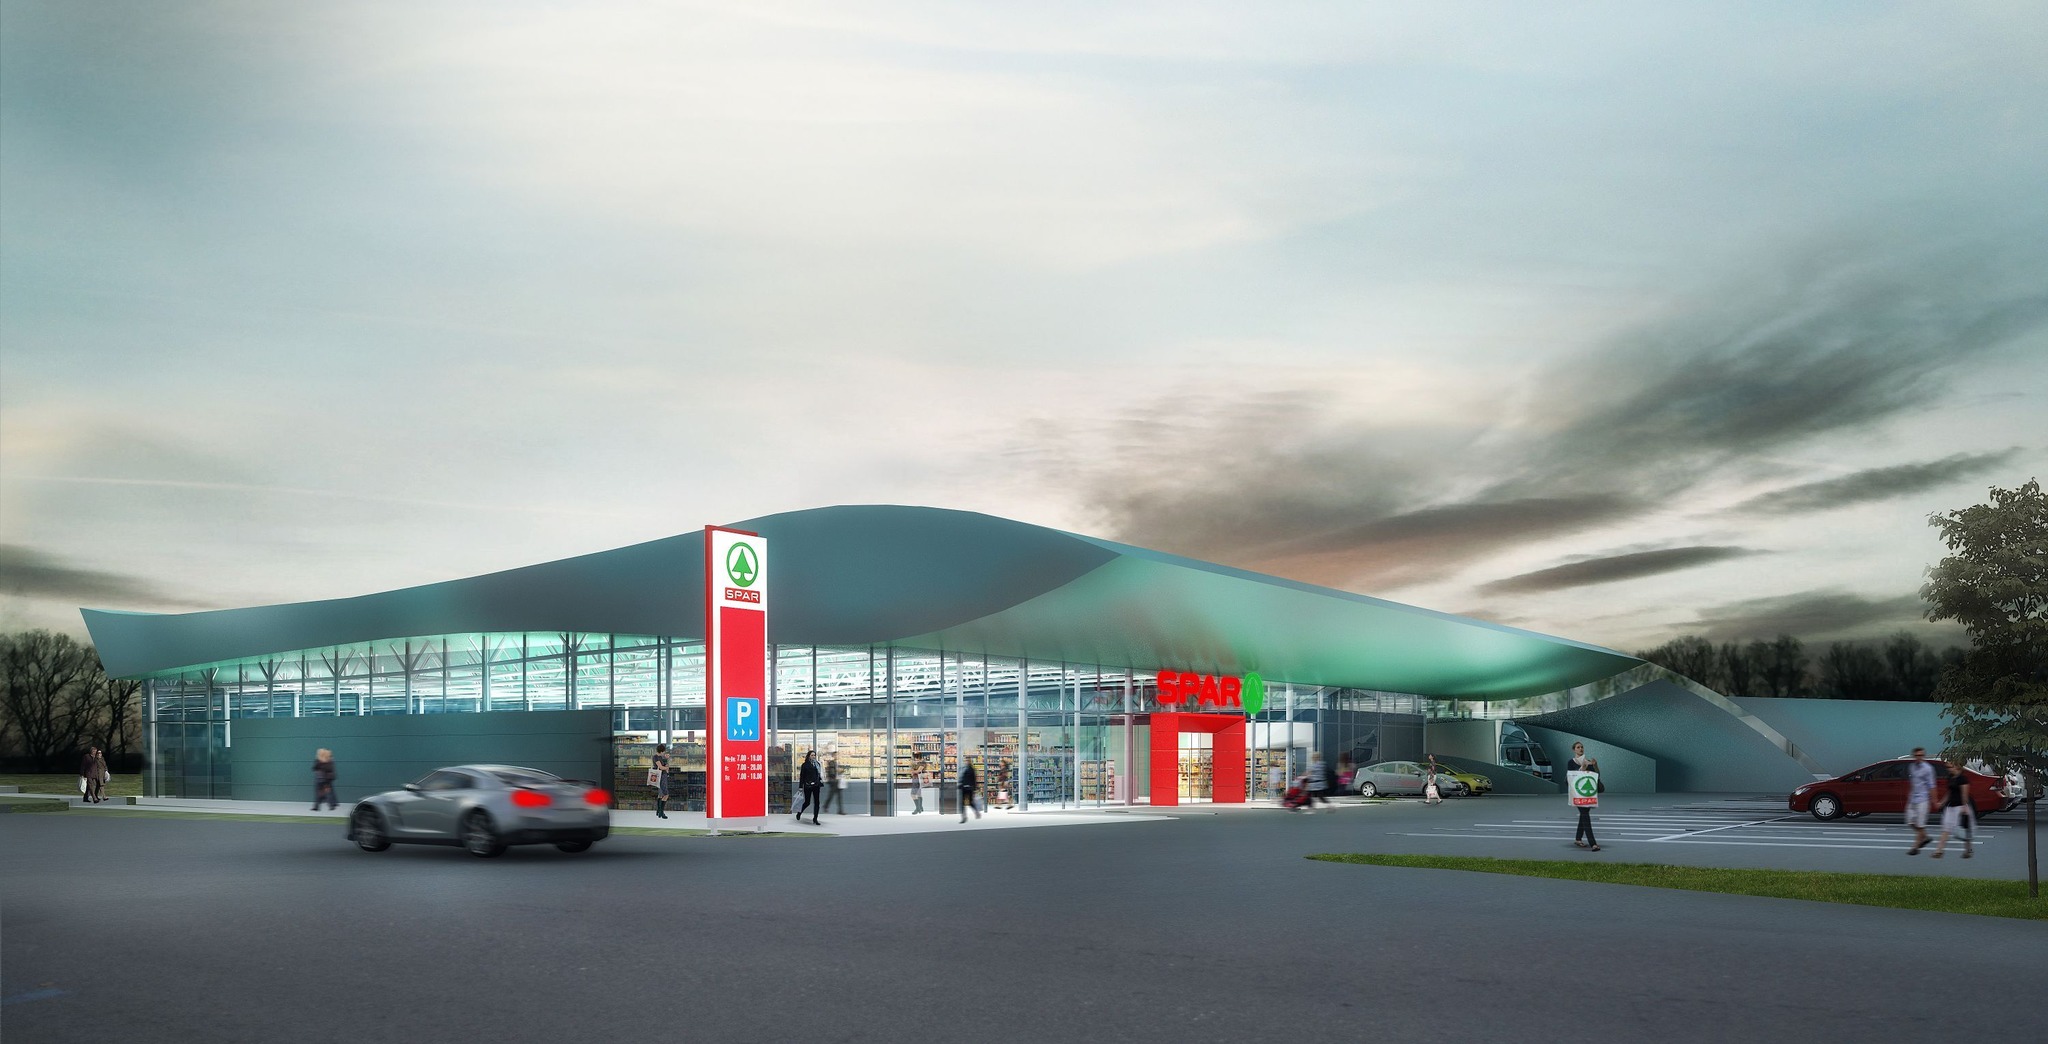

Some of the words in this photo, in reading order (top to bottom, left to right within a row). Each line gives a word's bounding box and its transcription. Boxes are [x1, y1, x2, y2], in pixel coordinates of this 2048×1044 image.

[726, 589, 759, 602] SPAR
[1157, 670, 1240, 707] SPAR
[737, 701, 752, 726] P
